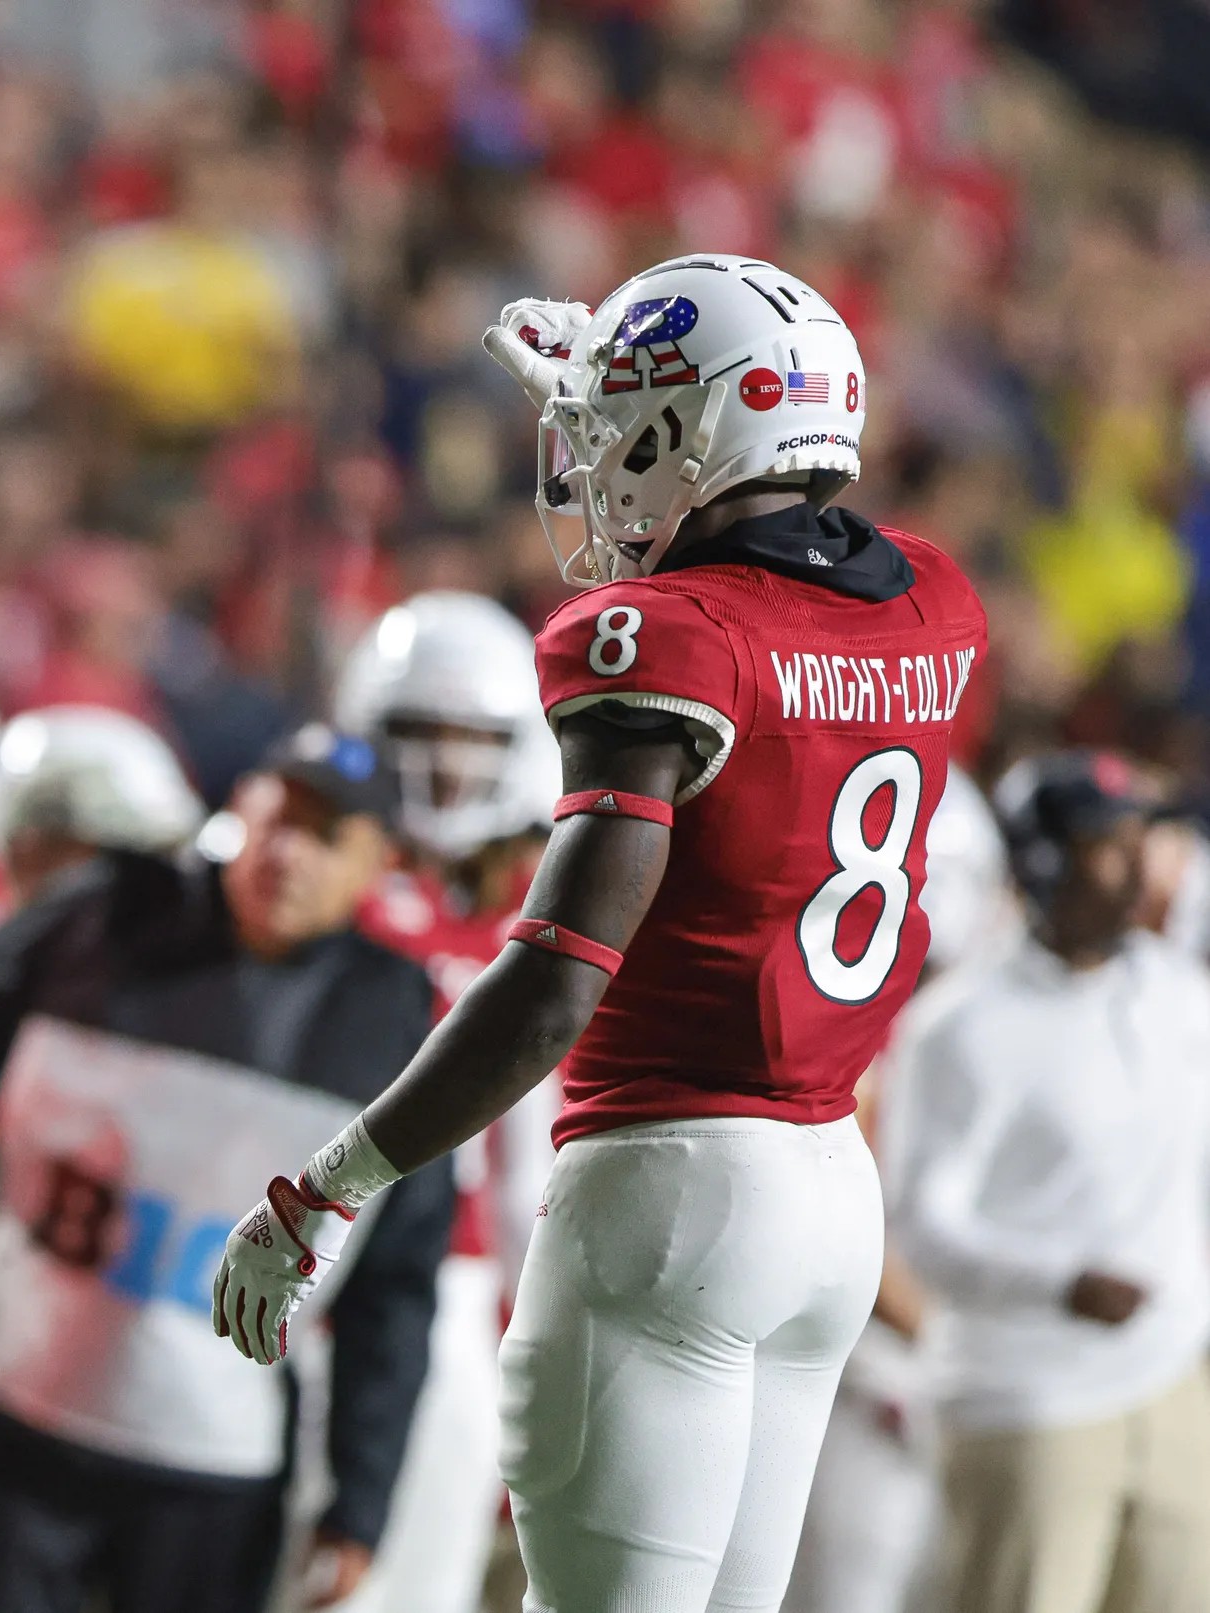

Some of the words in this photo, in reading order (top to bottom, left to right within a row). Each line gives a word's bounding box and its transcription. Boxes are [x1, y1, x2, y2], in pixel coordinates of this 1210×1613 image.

[600, 295, 700, 396] R
[846, 371, 859, 413] 8
[589, 605, 643, 676] 8
[794, 744, 924, 1006] 8
